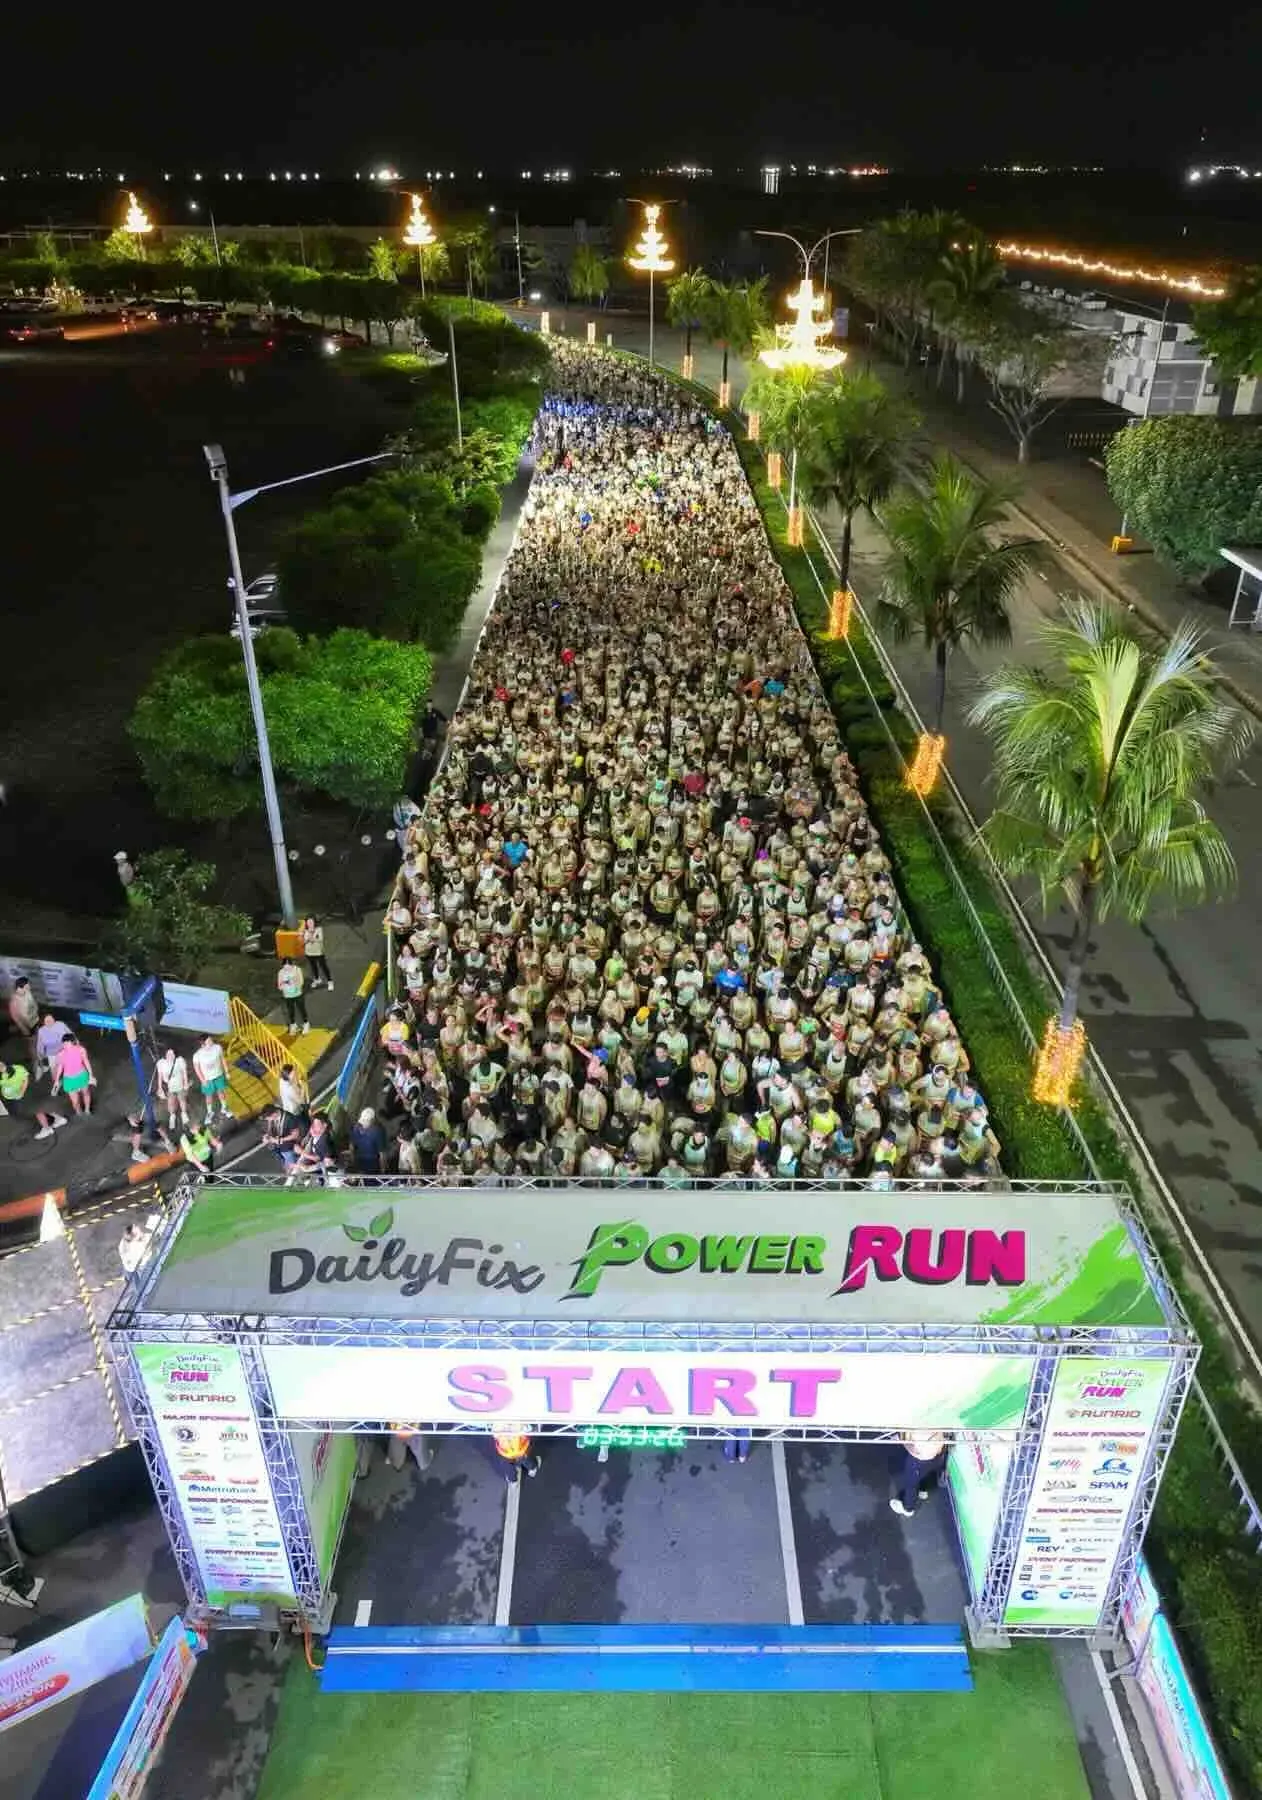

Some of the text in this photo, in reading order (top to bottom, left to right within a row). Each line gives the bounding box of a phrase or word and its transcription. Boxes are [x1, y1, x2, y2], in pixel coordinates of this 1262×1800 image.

[269, 1218, 1026, 1302] DailyFix POWER RUN
[170, 1371, 209, 1383] RUN
[447, 1364, 842, 1418] START
[1080, 1386, 1128, 1399] RUN
[179, 1394, 236, 1403] RUNRIO
[1081, 1410, 1142, 1418] RUNRIO
[1089, 1481, 1129, 1489] SPAM
